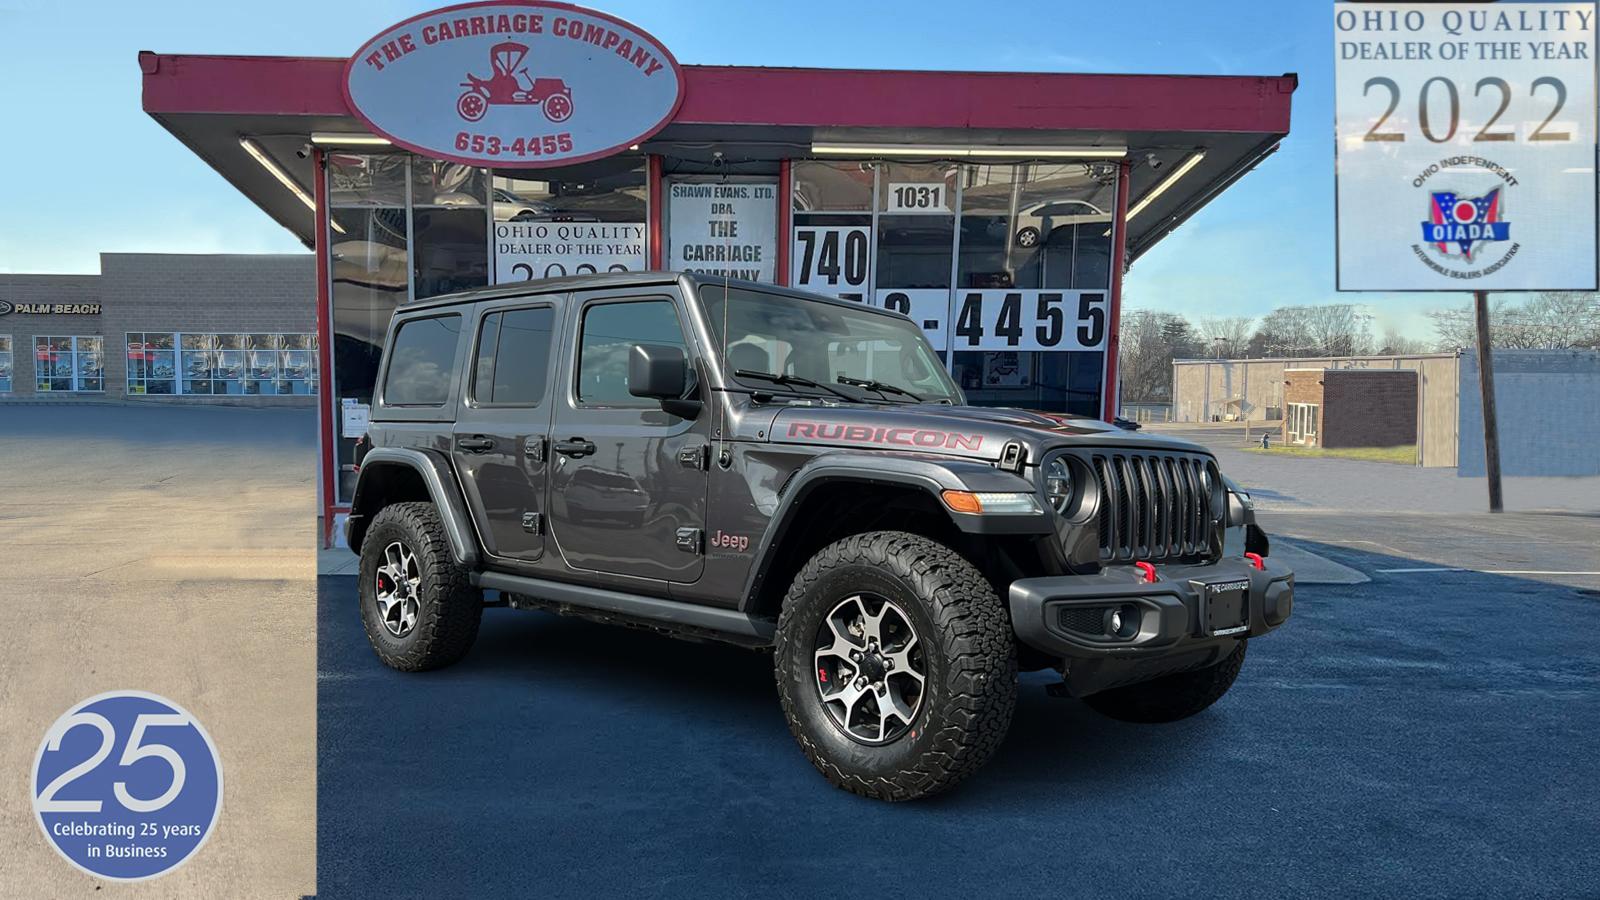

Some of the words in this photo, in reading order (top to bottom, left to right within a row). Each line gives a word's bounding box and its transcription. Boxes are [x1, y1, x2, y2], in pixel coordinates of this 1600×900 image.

[1337, 10, 1425, 31] OHIO
[1442, 10, 1593, 36] QUALITY
[366, 34, 415, 72] THE
[422, 15, 543, 44] CARRIAGE
[552, 17, 663, 77] COMPANY
[1341, 42, 1433, 60] DEALER
[1439, 41, 1469, 60] OF
[1475, 41, 1522, 60] THE
[1528, 41, 1589, 60] YEAR
[1363, 76, 1571, 143] 2022
[455, 132, 573, 156] 653-4455
[1413, 164, 1439, 188] OHIO
[1440, 156, 1519, 187] INDEPENDENT
[672, 187, 712, 198] SHAWN
[754, 187, 775, 199] LTD.
[895, 187, 941, 208] 1031
[497, 226, 549, 239] OHIO
[557, 226, 645, 241] QUALITY
[709, 221, 738, 238] THE
[1432, 225, 1495, 240] OIADA
[499, 243, 552, 255] DEALER
[555, 243, 573, 255] OF
[577, 243, 604, 255] THE
[607, 243, 641, 255] YEAR
[683, 245, 762, 262] CARRIAGE
[797, 230, 869, 286] 740
[14, 303, 52, 314] PALM
[54, 304, 100, 314] BEACH
[786, 422, 983, 451] RUBICON
[711, 530, 749, 552] Jeep
